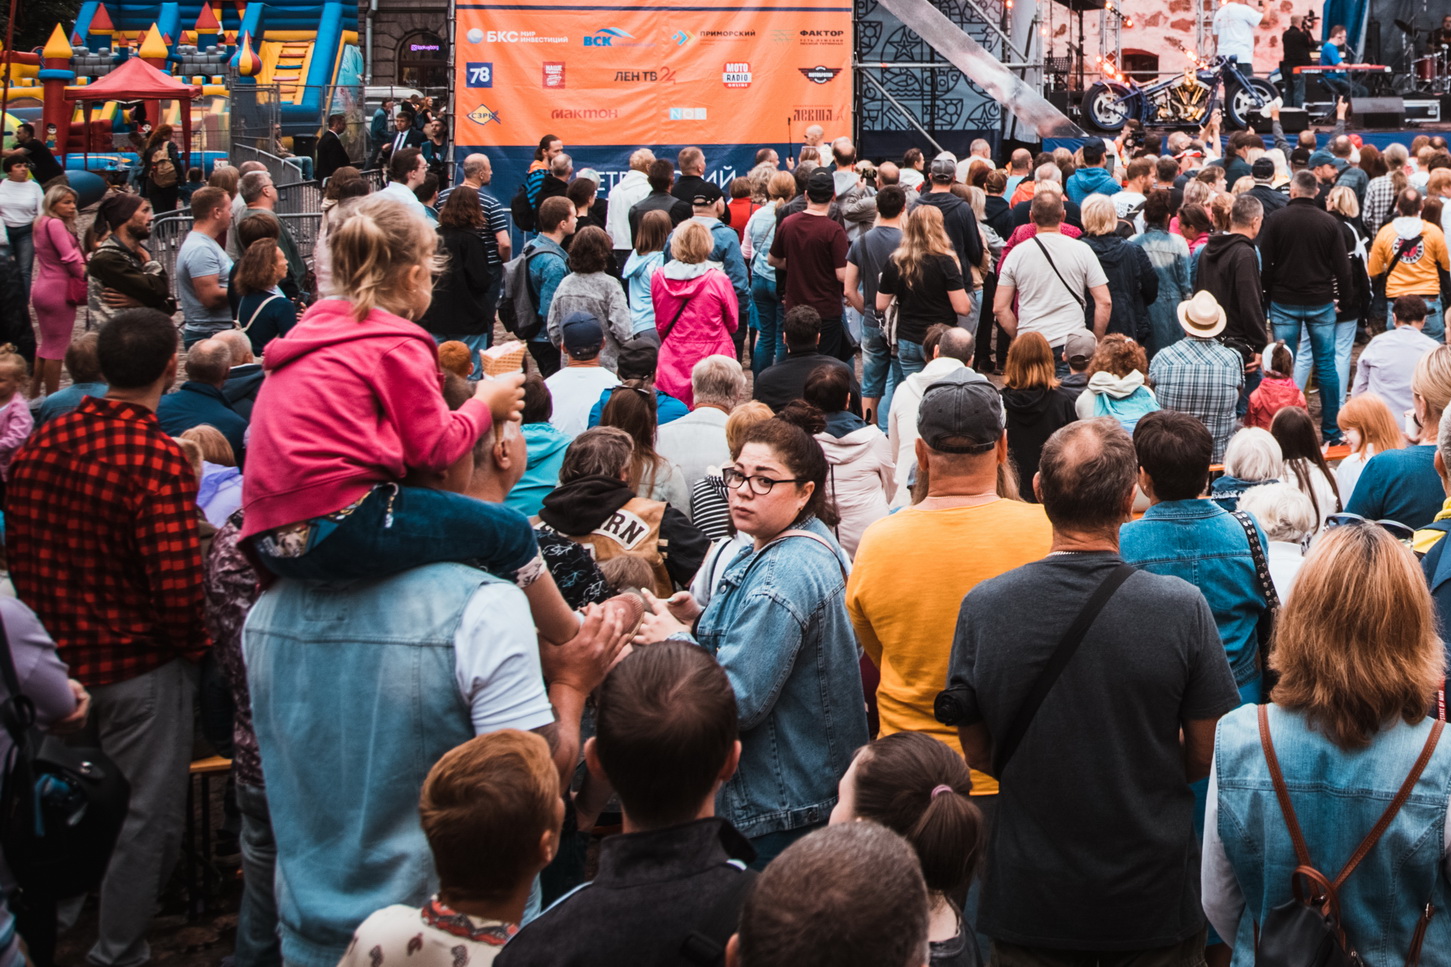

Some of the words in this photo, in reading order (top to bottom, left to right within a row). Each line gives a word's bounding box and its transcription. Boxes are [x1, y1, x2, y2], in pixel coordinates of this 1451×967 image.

[486, 31, 519, 43] БКС
[700, 29, 756, 37] ПРИМОРСКИЙ
[799, 29, 844, 37] ФАКТОР
[583, 36, 612, 47] ВСК
[726, 63, 749, 72] MOTO
[469, 66, 491, 84] 78
[614, 72, 640, 82] ЛЕН
[643, 72, 658, 82] ТВ
[726, 74, 748, 82] RADIO
